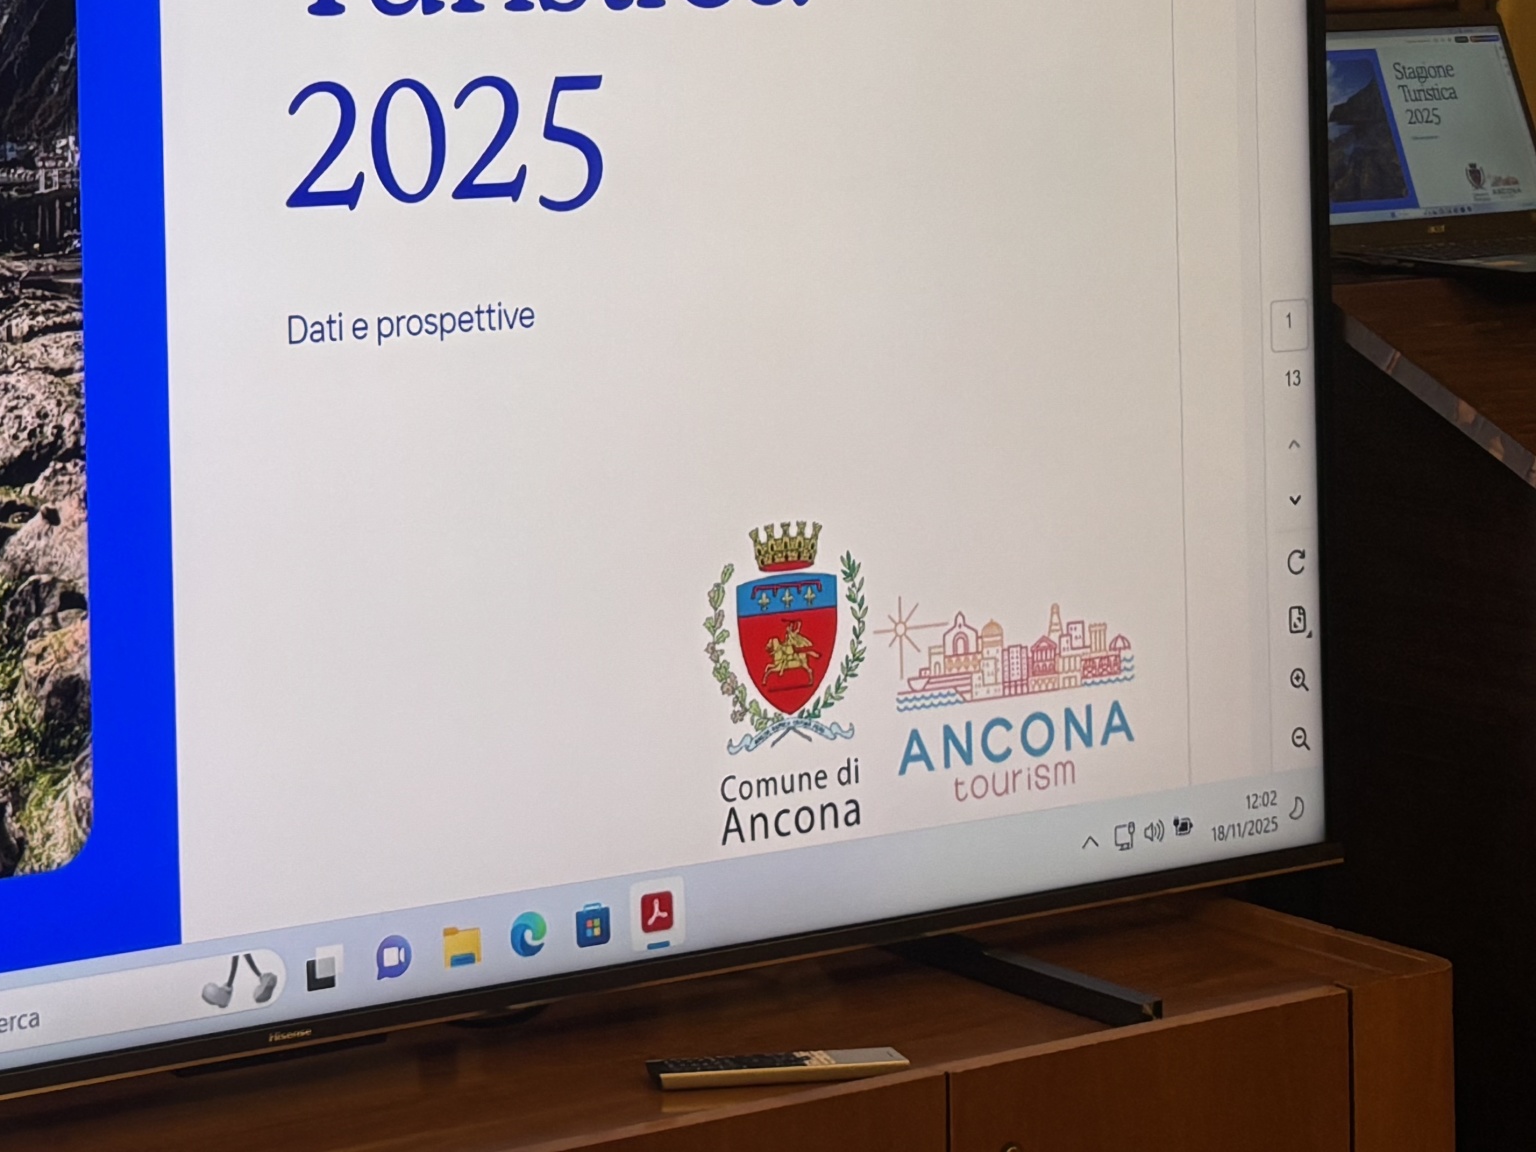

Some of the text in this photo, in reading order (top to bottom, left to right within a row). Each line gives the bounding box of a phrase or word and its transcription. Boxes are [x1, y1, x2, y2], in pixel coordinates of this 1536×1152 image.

[285, 74, 604, 213] 2025
[287, 301, 535, 347] Dati e prospettive
[1286, 312, 1292, 329] 1
[1285, 369, 1302, 387] 13
[896, 699, 1136, 777] ANCONA
[720, 757, 861, 804] Comune di
[954, 759, 1077, 804] tourism
[1245, 789, 1278, 810] 12:02
[720, 796, 862, 847] Ancona
[1210, 815, 1280, 843] 18/11/2025
